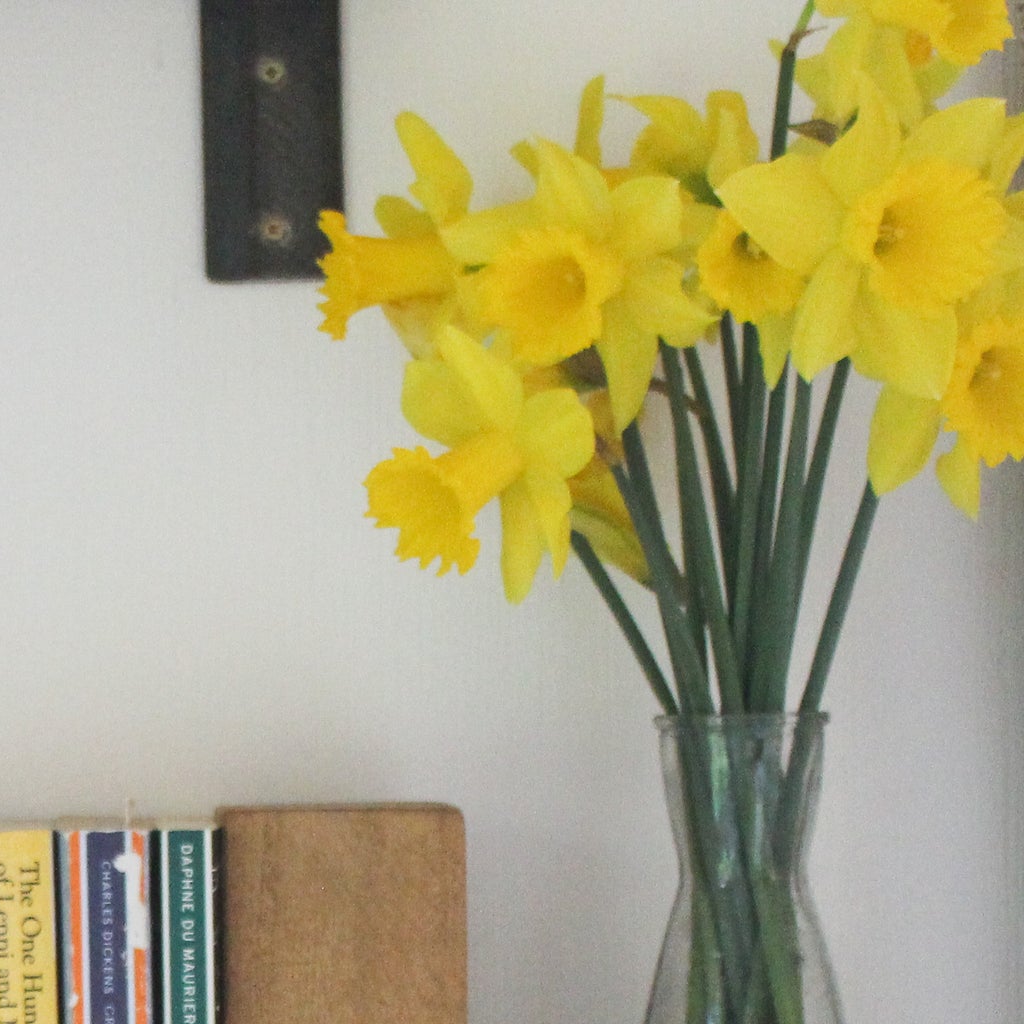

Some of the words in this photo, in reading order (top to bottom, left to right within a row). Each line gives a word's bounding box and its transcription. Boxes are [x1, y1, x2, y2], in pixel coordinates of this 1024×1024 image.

[19, 861, 41, 908] The
[101, 861, 113, 926] CHARLES
[180, 844, 195, 912] DAPHNE
[21, 916, 42, 965] One
[181, 920, 195, 942] DU
[103, 930, 116, 995] DICKENS
